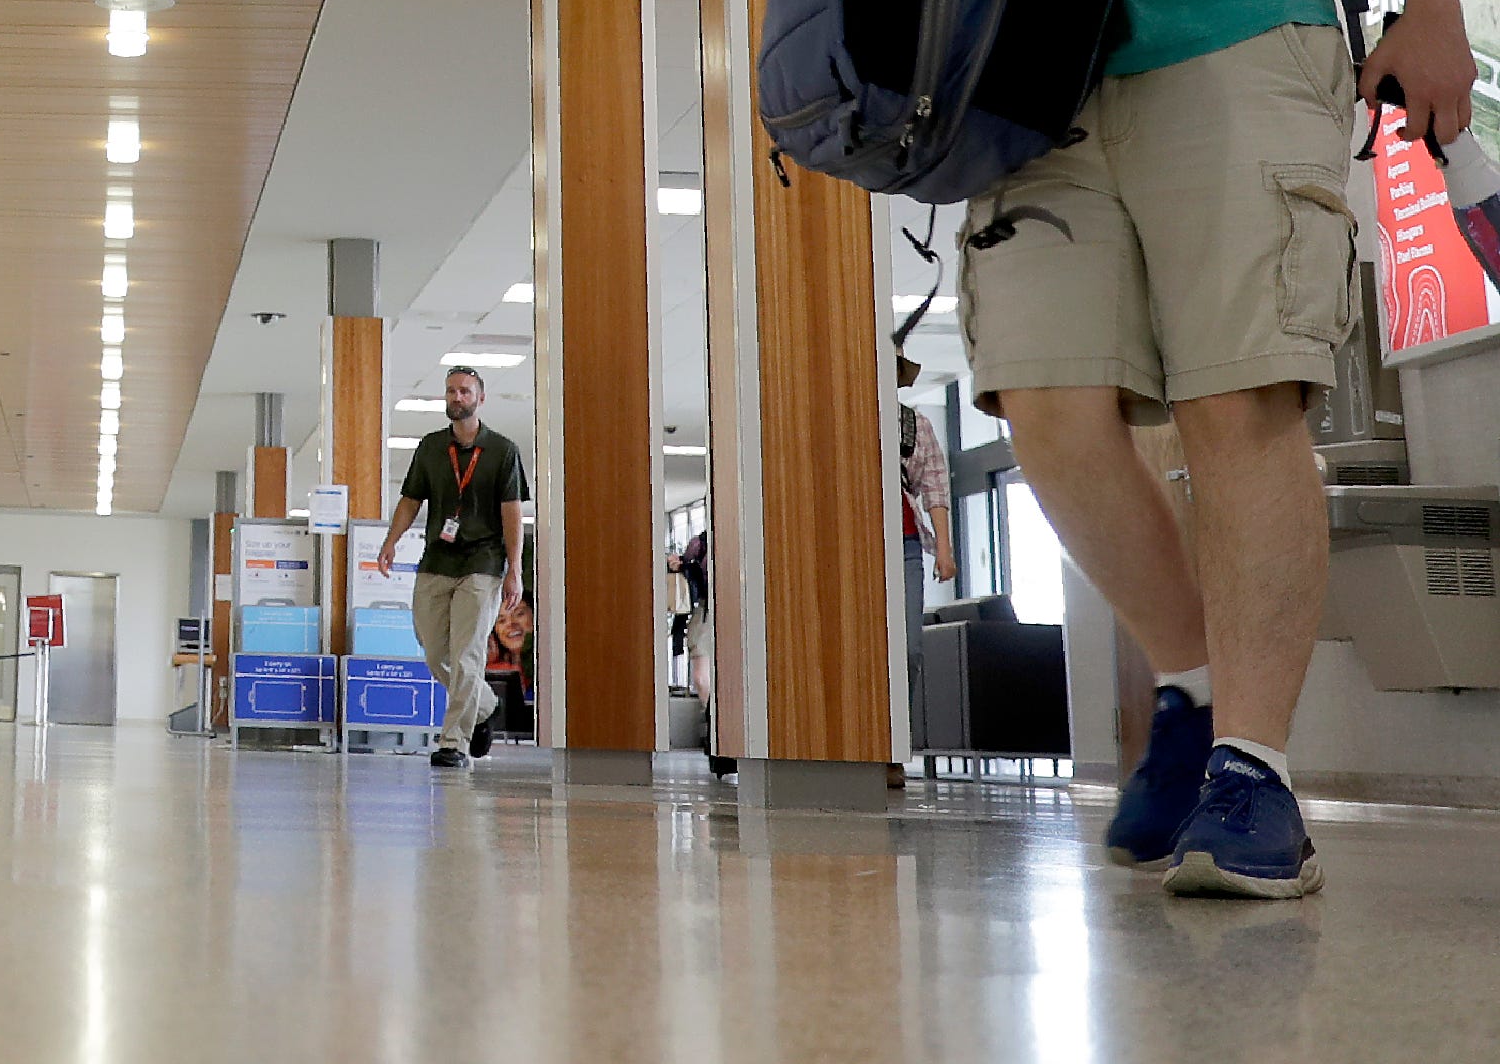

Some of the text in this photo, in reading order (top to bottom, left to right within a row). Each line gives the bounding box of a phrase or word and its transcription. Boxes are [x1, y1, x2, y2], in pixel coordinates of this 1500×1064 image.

[1390, 182, 1415, 200] Parking
[1393, 191, 1449, 221] Terminal Buildings
